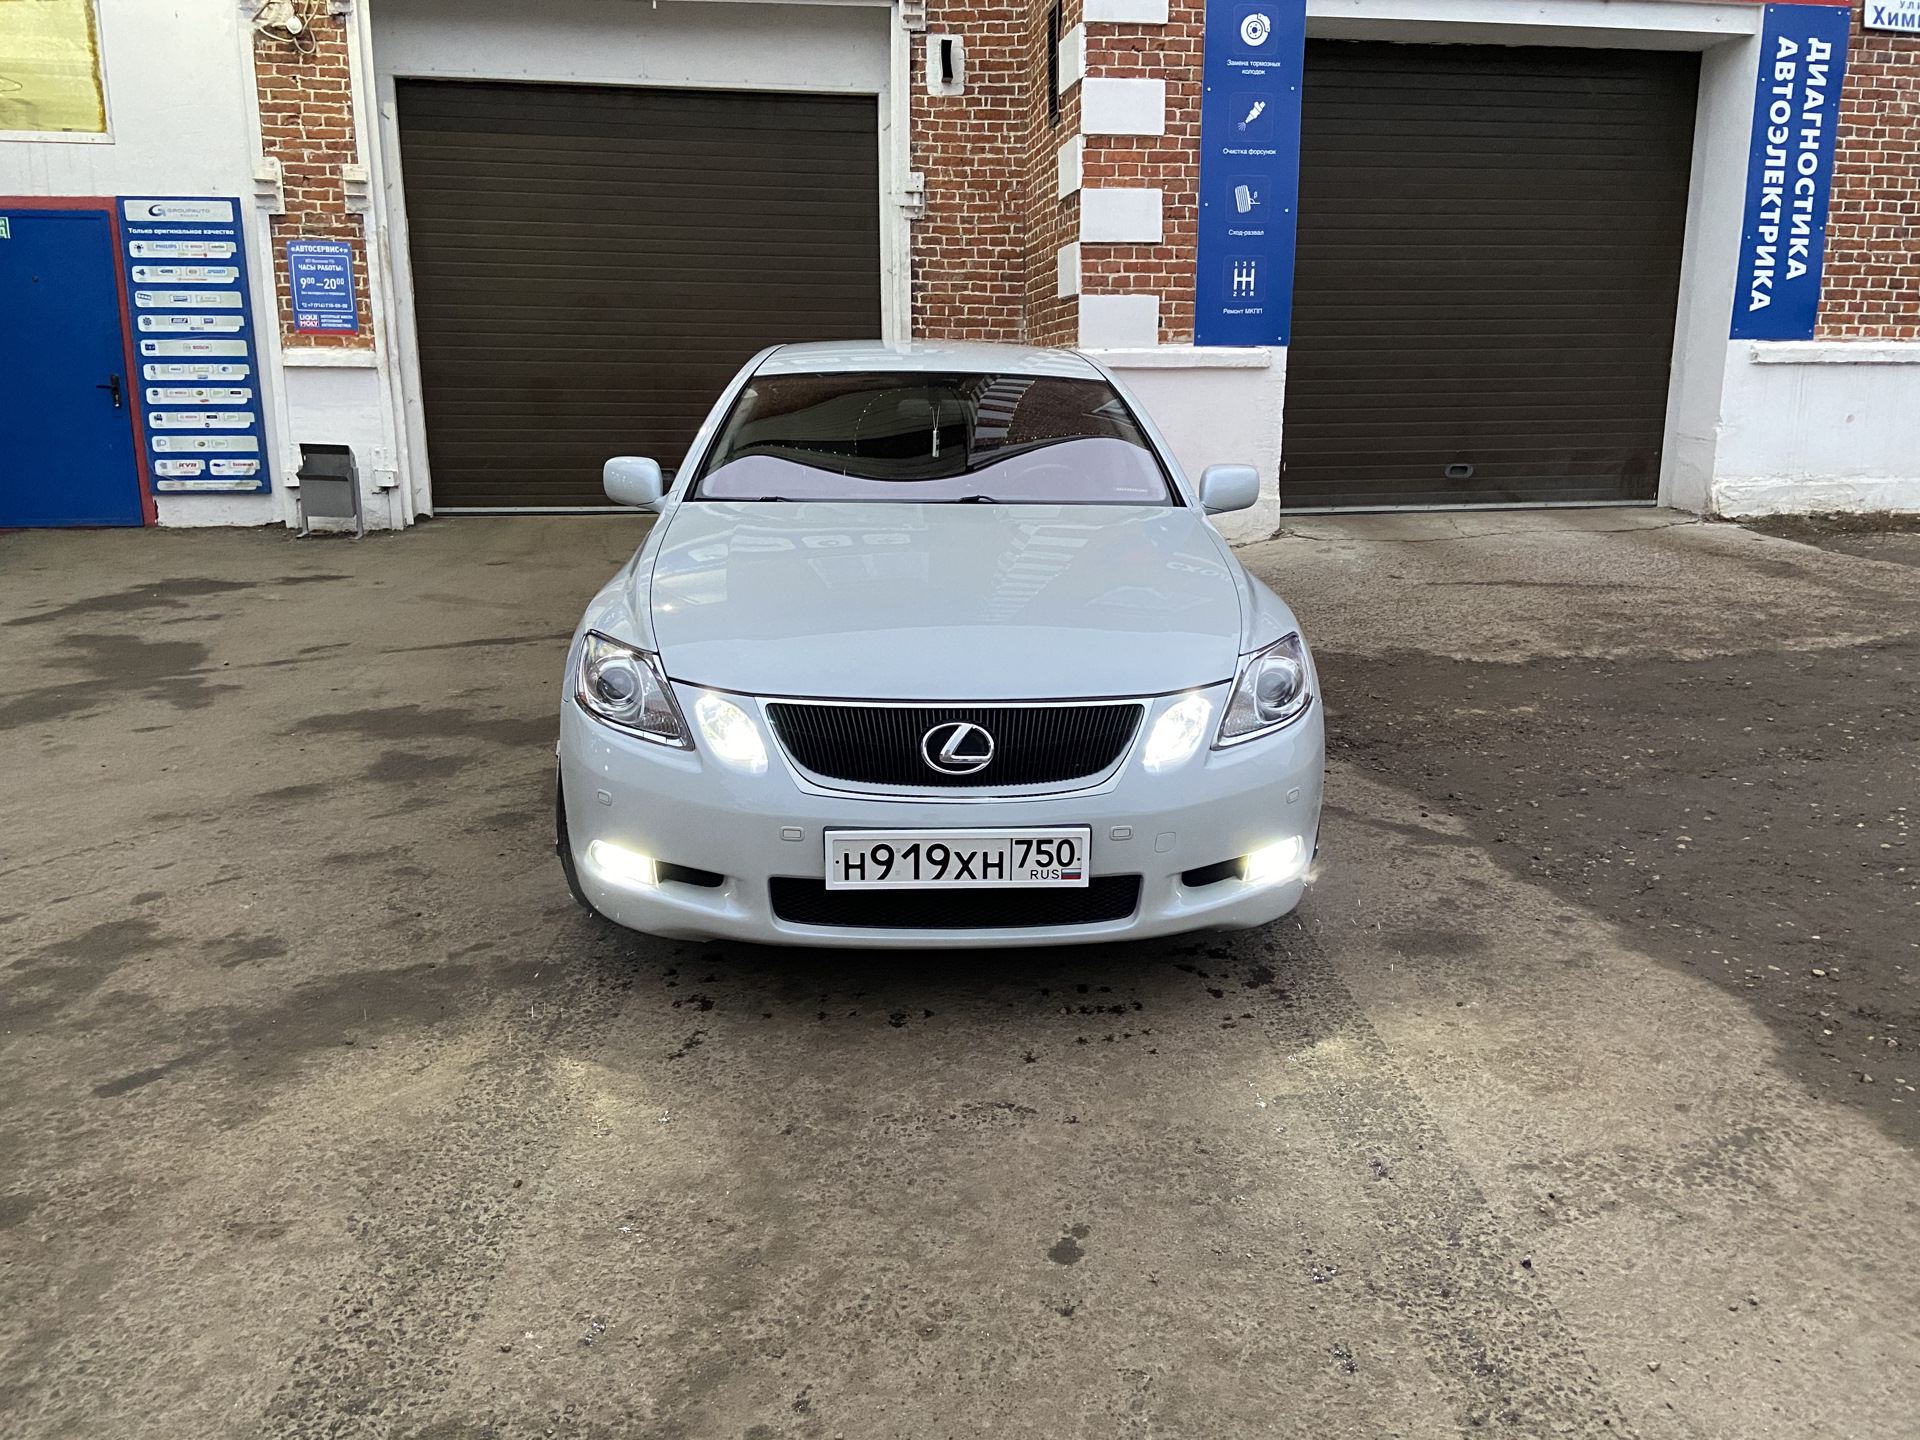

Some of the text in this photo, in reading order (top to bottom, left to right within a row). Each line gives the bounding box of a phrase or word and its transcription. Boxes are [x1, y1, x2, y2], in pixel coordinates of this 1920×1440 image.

[1222, 147, 1277, 156] Очистка форсунок
[1786, 37, 1832, 281] ДИАГНОСТИКА
[1749, 35, 1799, 312] АВТОЭЛЕКТРИКА
[153, 228, 202, 236] оригинальное
[1014, 839, 1076, 868] 750
[1030, 869, 1060, 880] RUS
